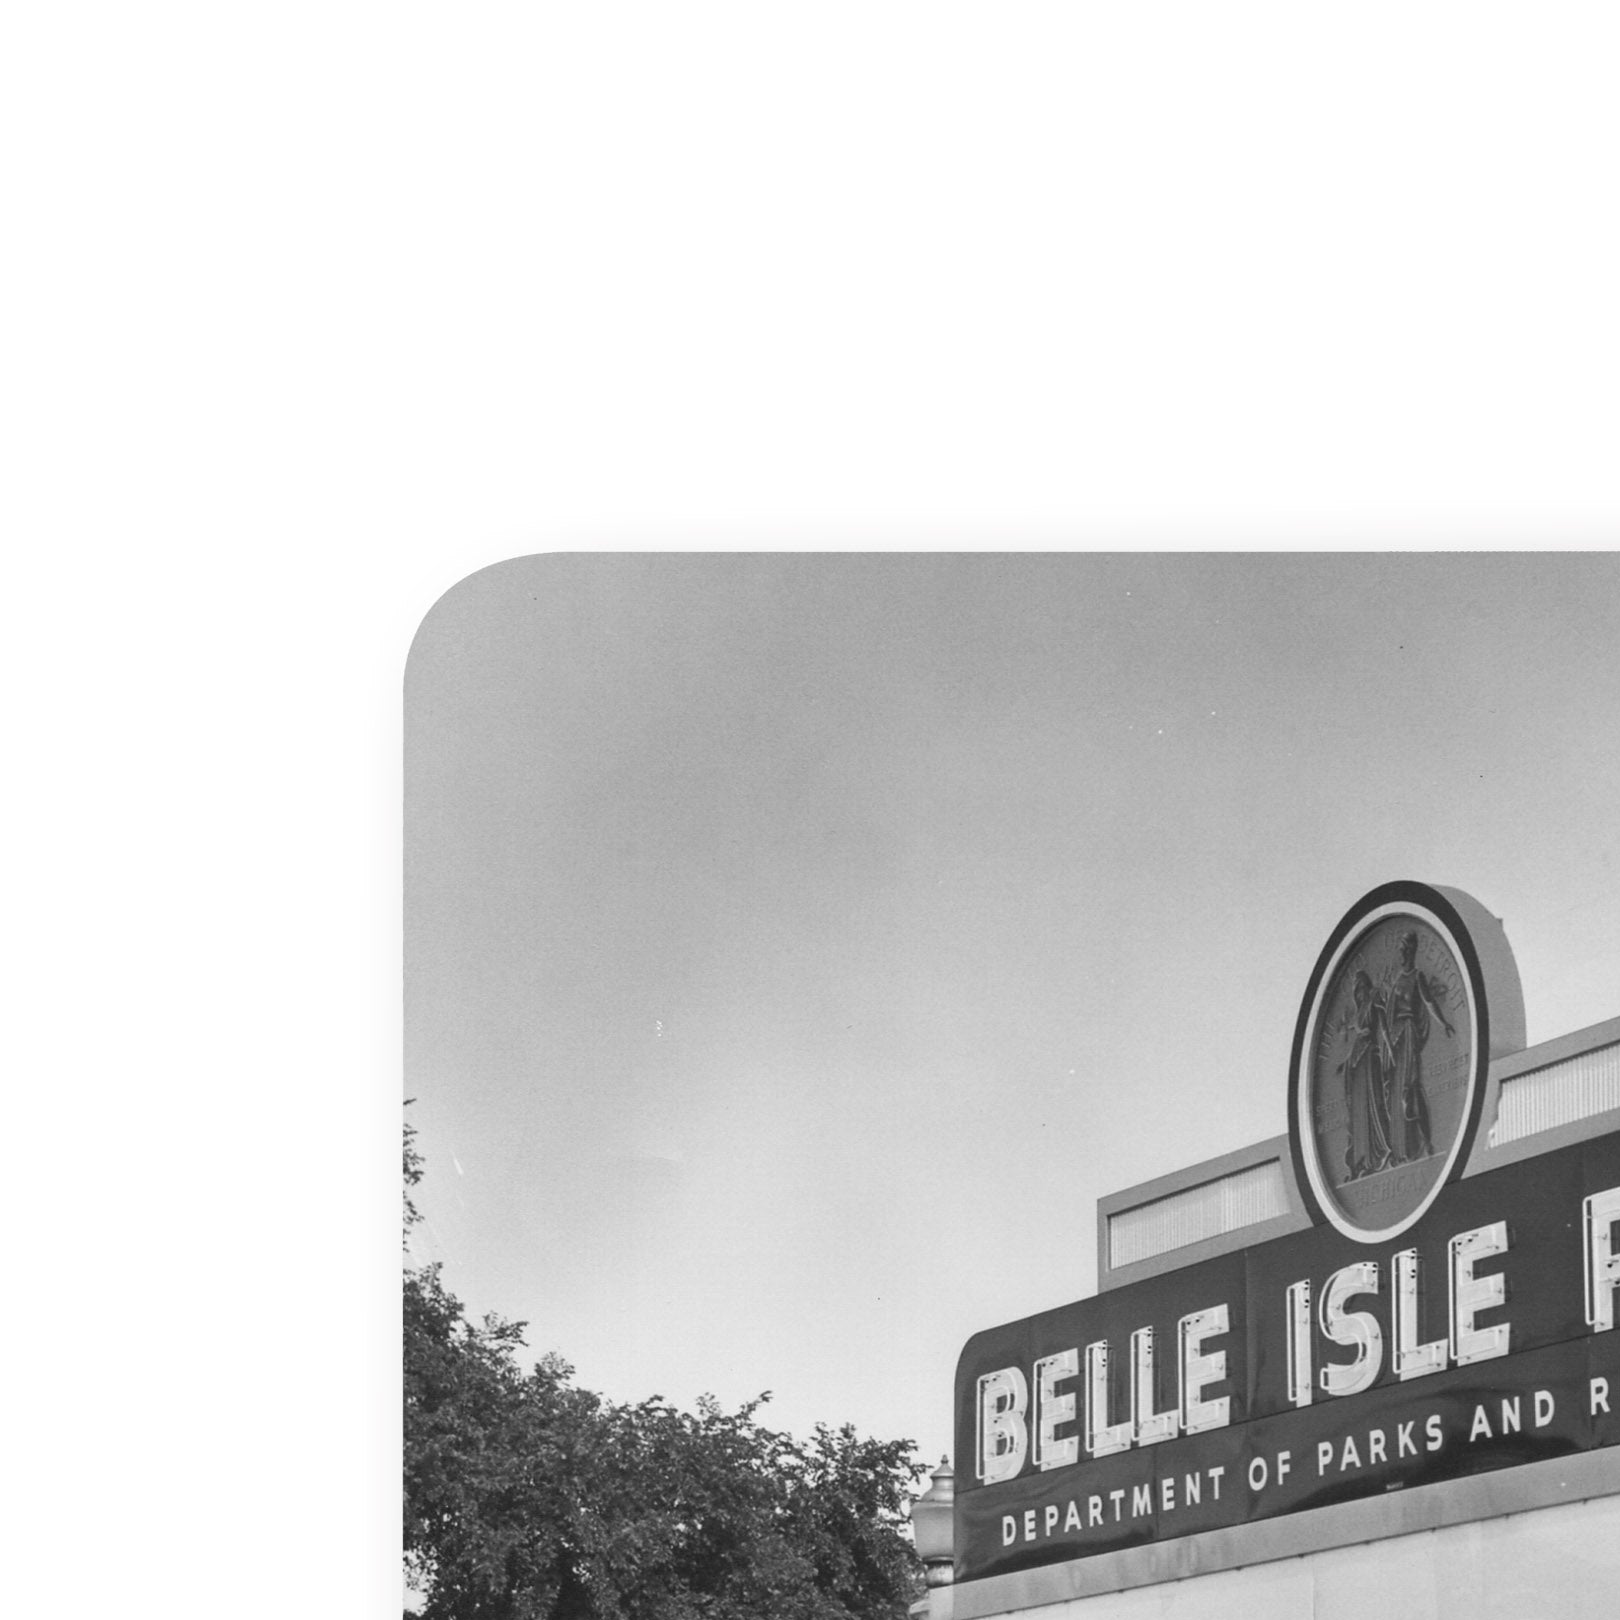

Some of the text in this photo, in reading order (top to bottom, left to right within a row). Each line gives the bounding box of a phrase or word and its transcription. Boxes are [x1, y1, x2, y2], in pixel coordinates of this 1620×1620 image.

[975, 1302, 1231, 1487] BELLE
[1285, 1220, 1511, 1409] ISLE
[1002, 1465, 1225, 1547] DEPARTMENT
[1248, 1450, 1291, 1492] OF
[1317, 1414, 1443, 1477] PARKS
[1469, 1389, 1555, 1442] AND
